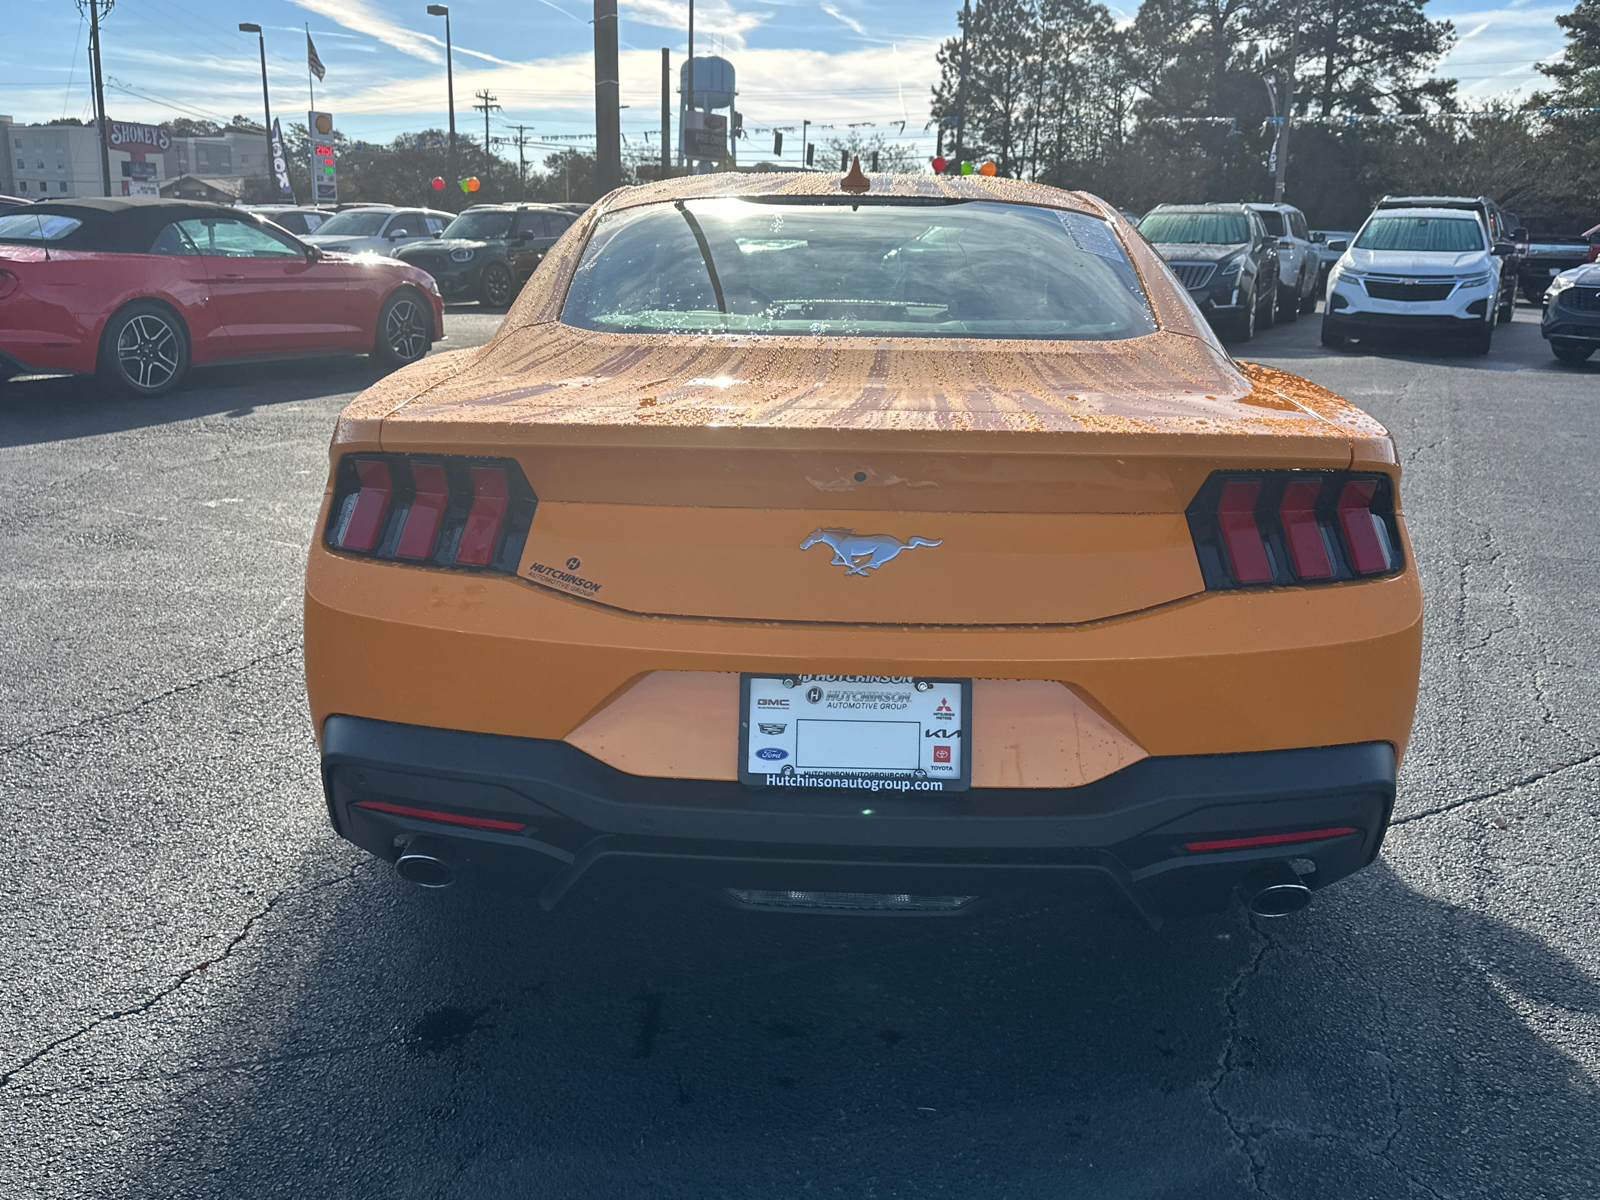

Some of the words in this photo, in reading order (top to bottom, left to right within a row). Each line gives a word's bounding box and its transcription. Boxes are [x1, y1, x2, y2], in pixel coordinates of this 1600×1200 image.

[111, 123, 170, 149] SHONEY'S
[528, 571, 570, 590] AUTOMOTIVE
[570, 585, 594, 597] GROUP
[529, 562, 602, 592] HUTCHINSON
[757, 698, 790, 707] GMC
[825, 690, 911, 703] HUTCHINSON
[826, 702, 878, 710] AUTOMOTIVE
[880, 703, 908, 711] GROUP
[761, 749, 782, 759] Ford
[766, 774, 943, 792] Hutchinsonautogroup.com
